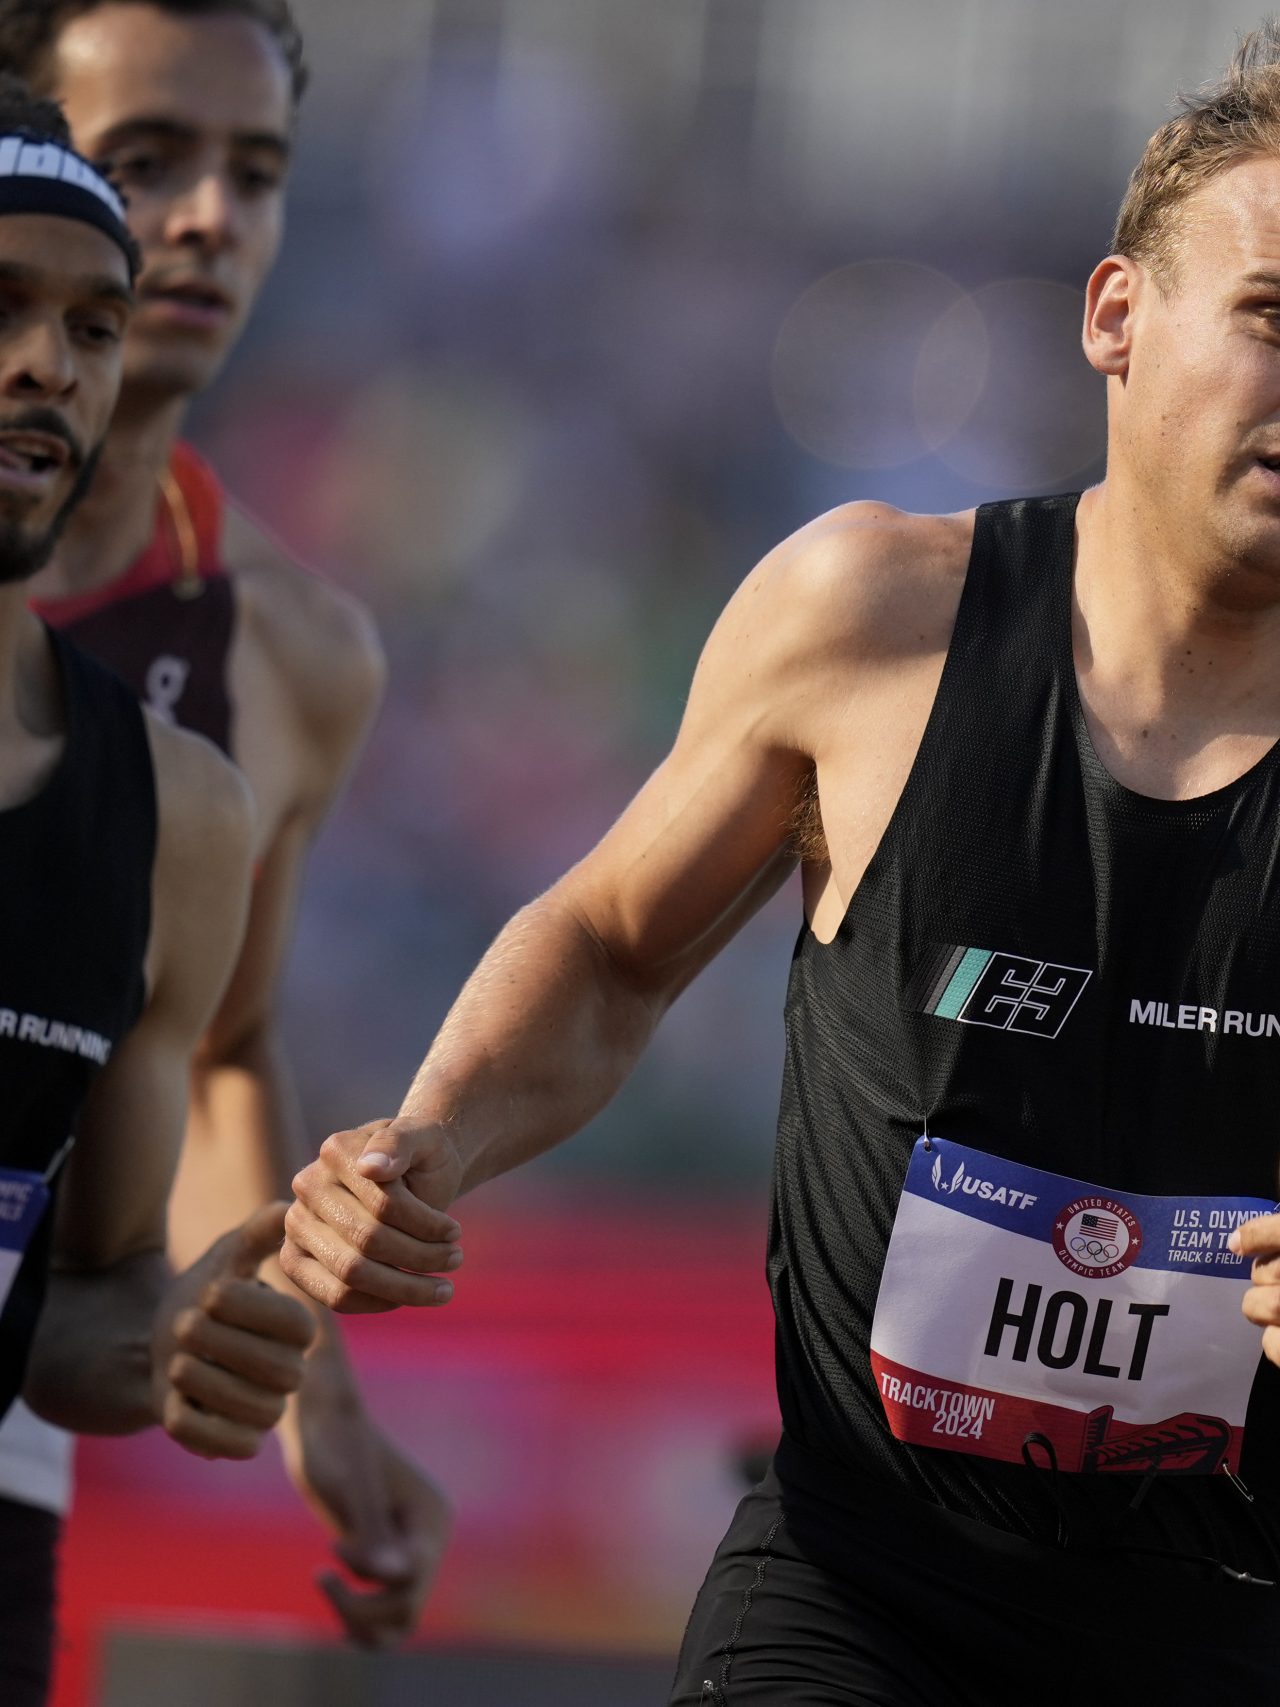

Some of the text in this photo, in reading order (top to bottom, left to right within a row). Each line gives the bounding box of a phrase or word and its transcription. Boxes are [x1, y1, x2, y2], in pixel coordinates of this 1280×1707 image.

[1129, 999, 1217, 1033] MILER
[961, 1176, 1038, 1210] USATF
[1067, 1198, 1136, 1227] UNITED STATES
[1173, 1209, 1203, 1228] U.S.
[1170, 1230, 1213, 1249] TEAM
[1058, 1249, 1125, 1276] OLYMPIC TEAM
[1168, 1250, 1243, 1265] TRACK & FIELD
[983, 1277, 1170, 1381] HOLT
[880, 1372, 996, 1421] TRACKTOWN
[932, 1410, 983, 1440] 2024
